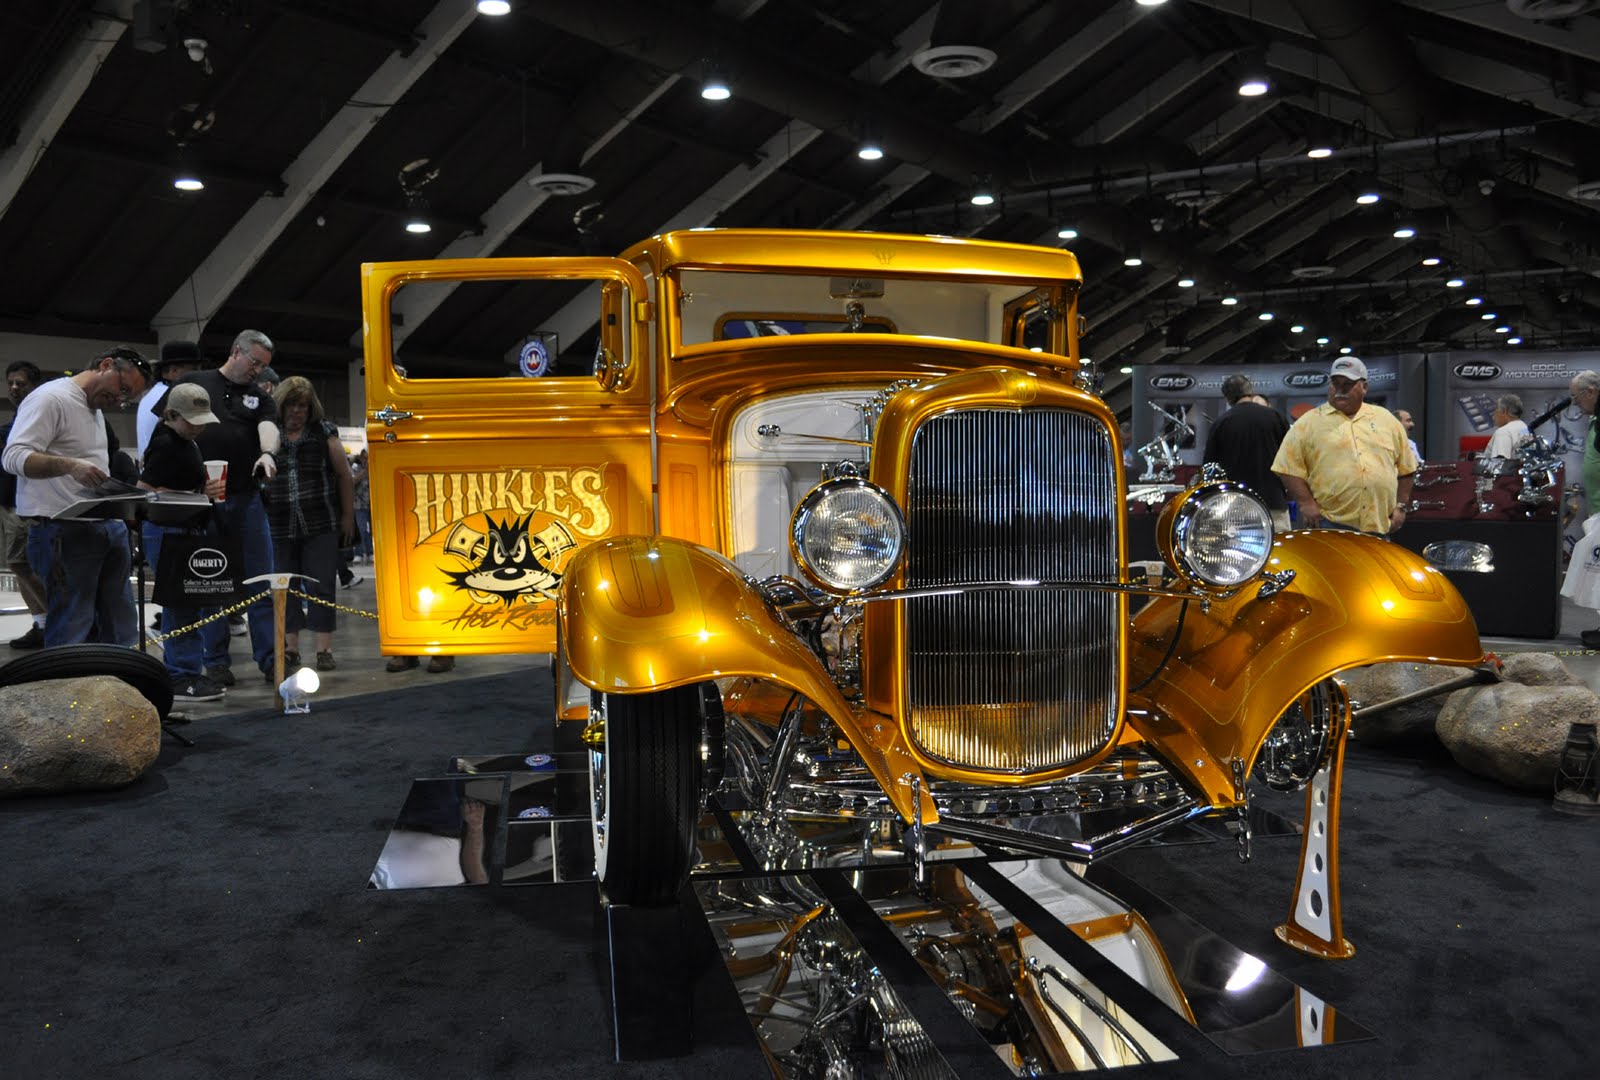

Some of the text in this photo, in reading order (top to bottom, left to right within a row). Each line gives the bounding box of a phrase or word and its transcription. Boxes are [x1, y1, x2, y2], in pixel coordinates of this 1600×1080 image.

[1461, 366, 1495, 377] EMS
[1532, 363, 1565, 371] EDDIE
[1157, 378, 1188, 387] EMS
[1291, 374, 1325, 385] EMS
[407, 464, 611, 546] HINKLES
[192, 558, 223, 568] HAGERTY
[443, 603, 504, 631] Hot
